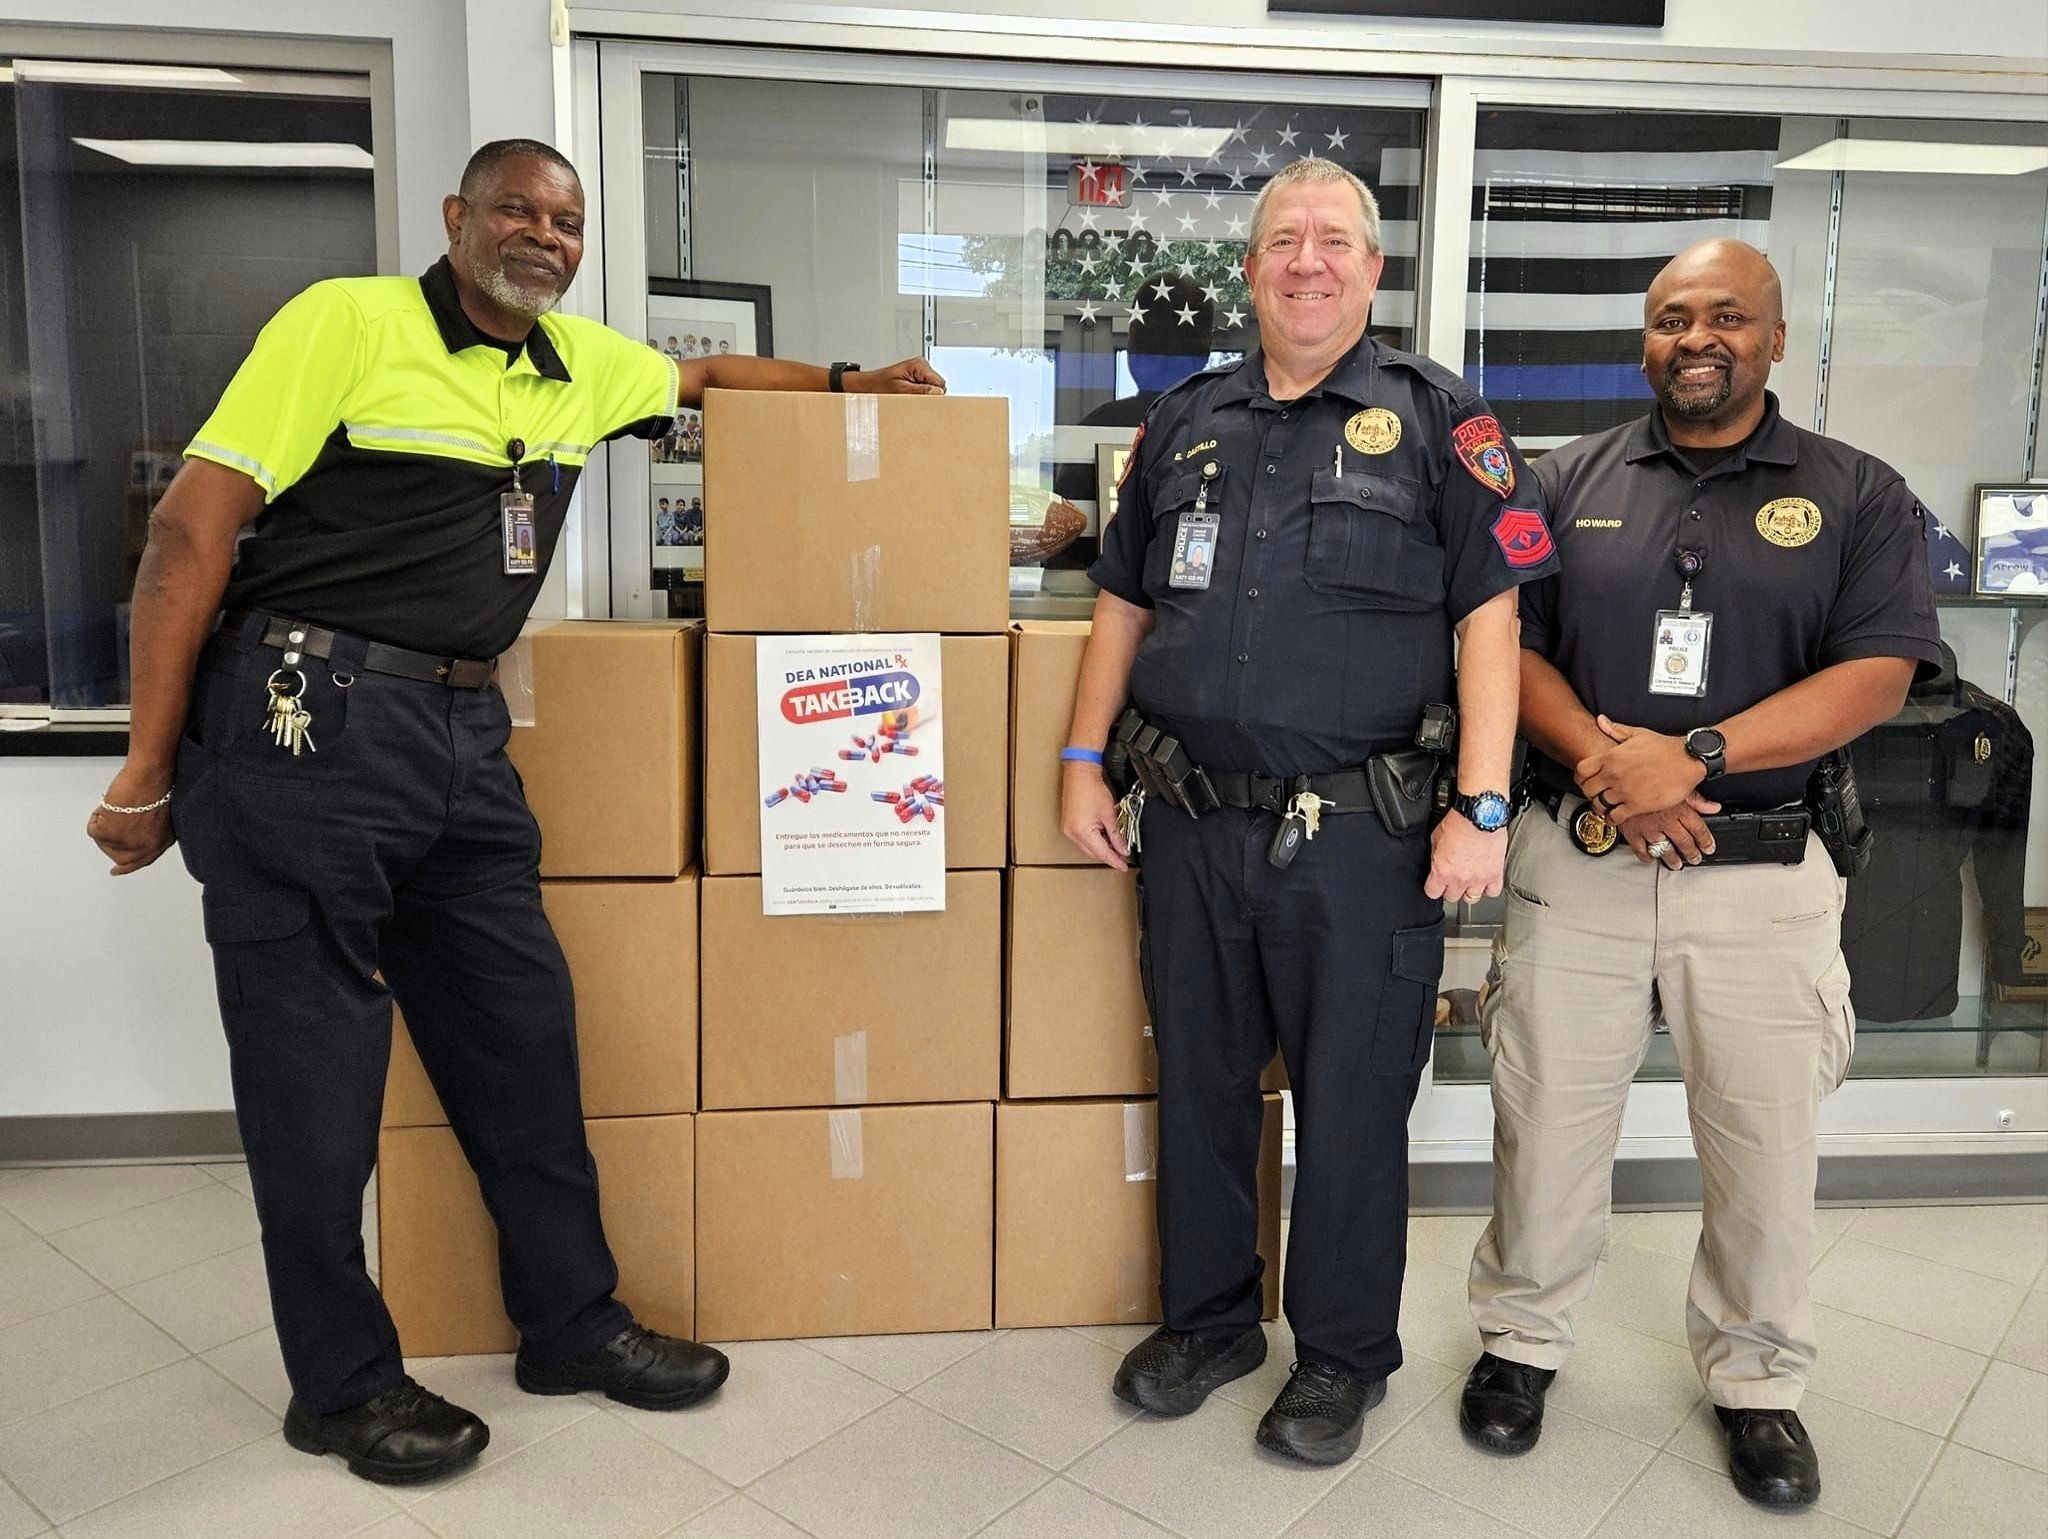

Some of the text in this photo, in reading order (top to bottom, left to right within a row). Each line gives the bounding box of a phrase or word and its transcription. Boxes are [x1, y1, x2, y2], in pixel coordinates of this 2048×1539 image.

[1457, 418, 1499, 445] POLICE
[1576, 519, 1622, 528] HOWARD
[1177, 527, 1188, 558] POLICE
[1992, 563, 2029, 571] Arrow
[785, 669, 815, 684] DEA
[819, 658, 893, 679] NATIONAL
[775, 833, 808, 841] Entregue
[822, 830, 874, 839] medicamentos
[875, 830, 889, 839] que
[901, 829, 931, 837] necesita
[784, 843, 800, 851] para
[802, 843, 815, 851] que
[827, 841, 861, 849] desechen
[873, 840, 895, 848] forma
